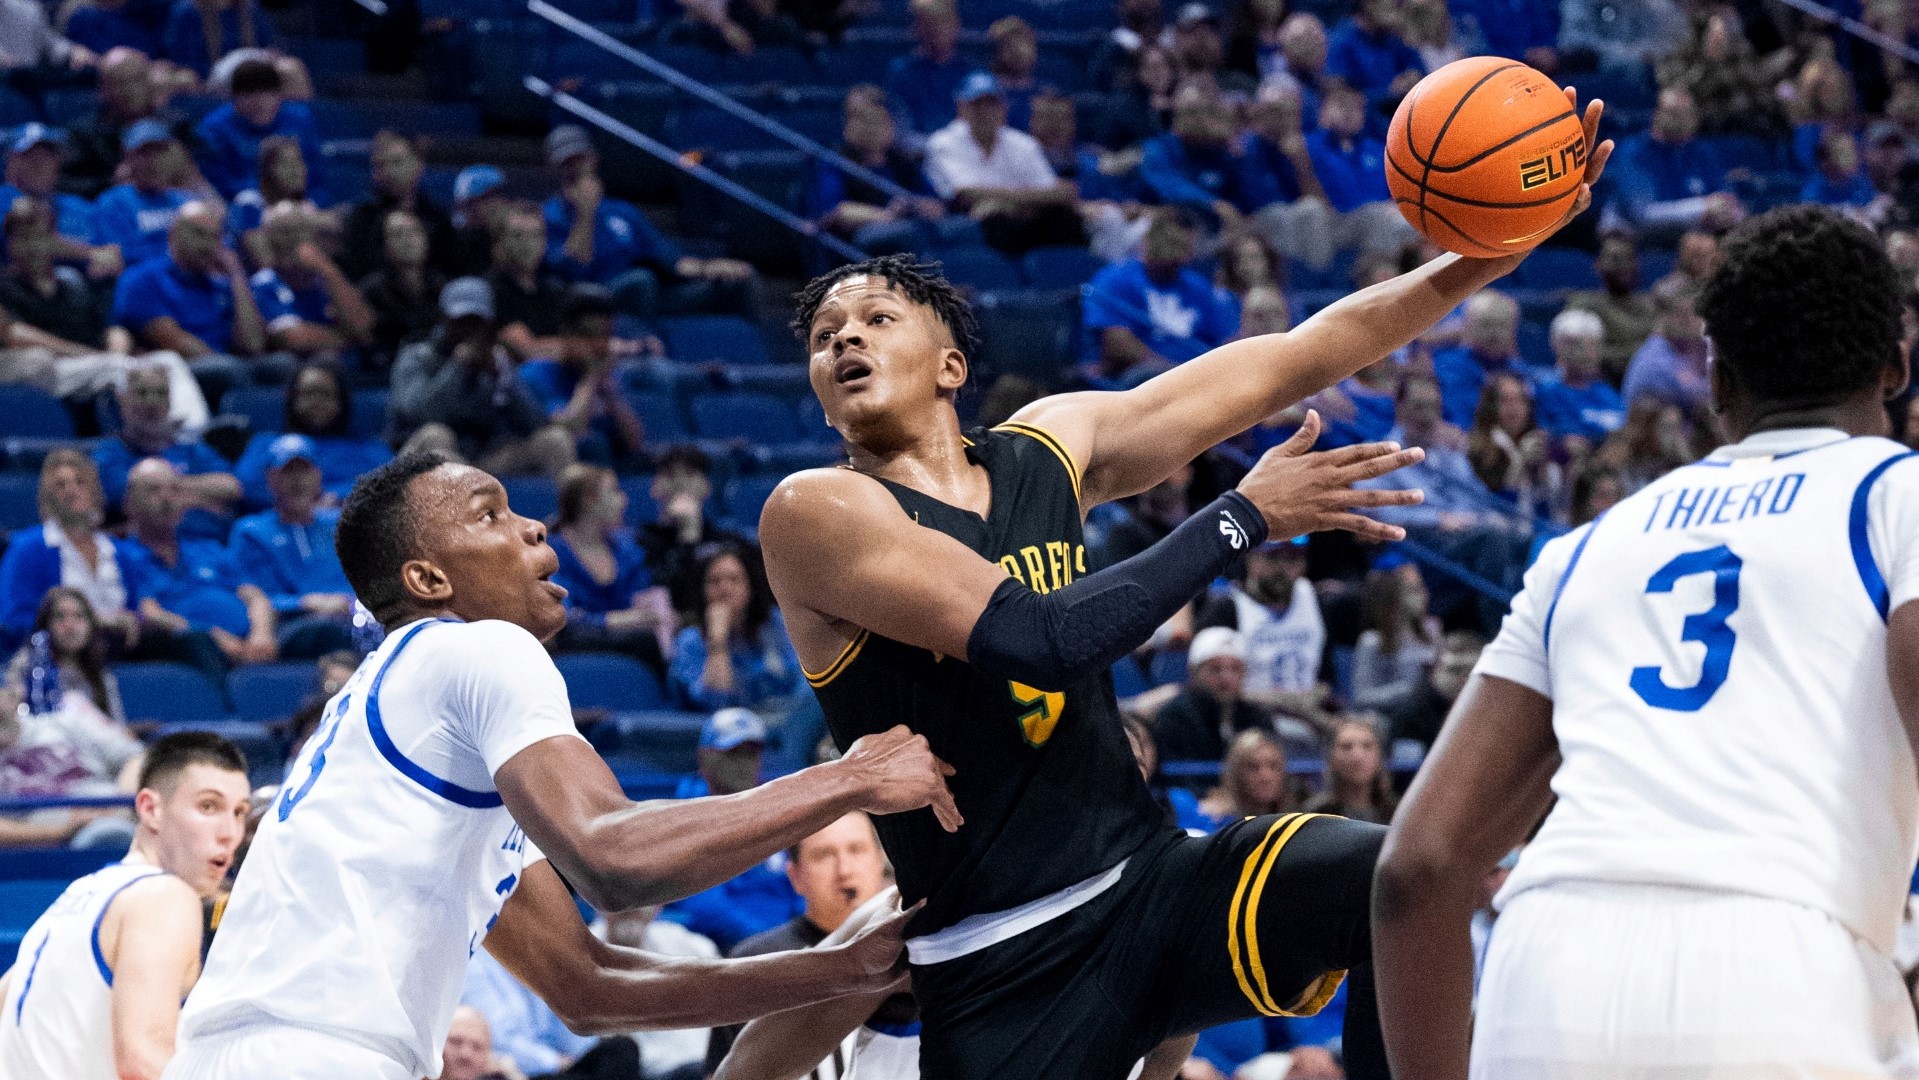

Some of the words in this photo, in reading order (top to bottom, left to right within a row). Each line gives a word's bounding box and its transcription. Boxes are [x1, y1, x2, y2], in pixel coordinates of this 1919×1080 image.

[1519, 134, 1587, 191] ELITE
[1643, 473, 1806, 533] THIERO
[1629, 544, 1743, 712] 3
